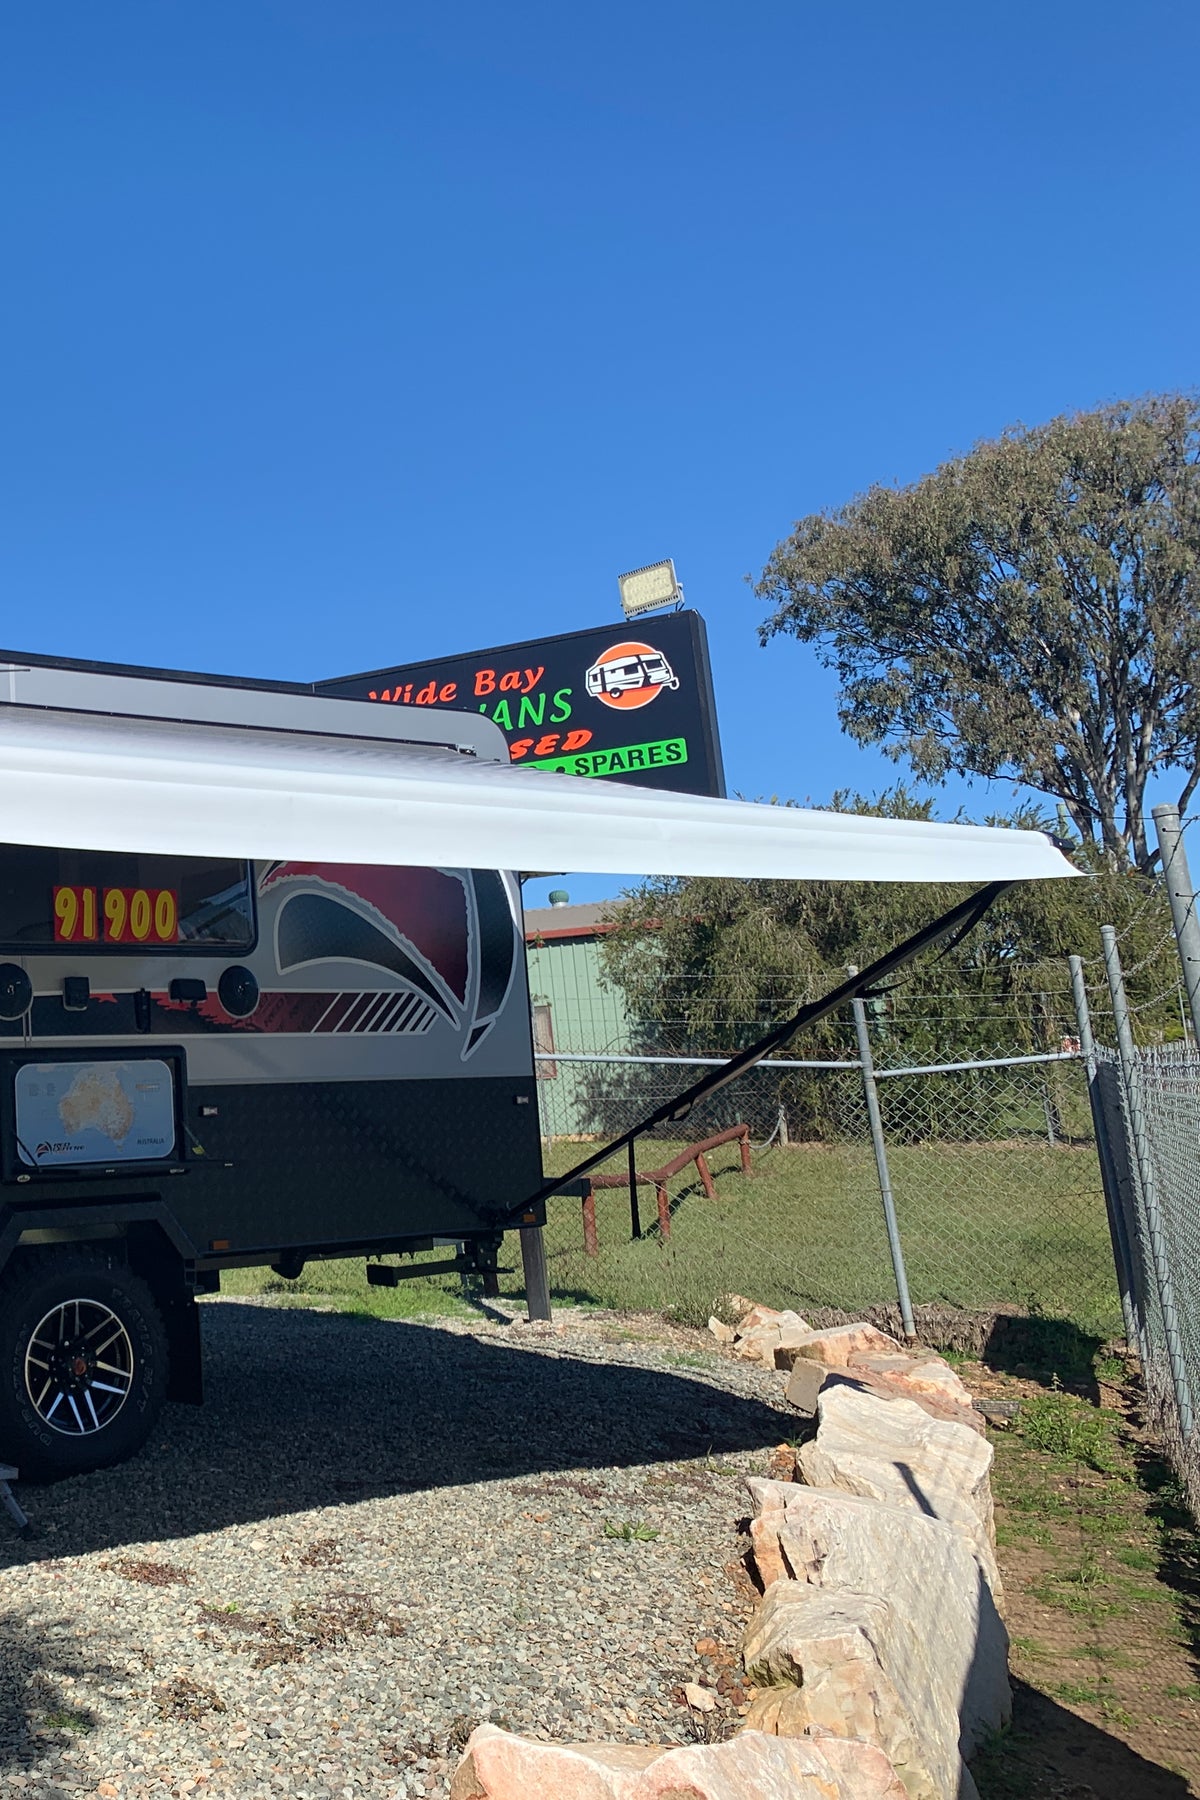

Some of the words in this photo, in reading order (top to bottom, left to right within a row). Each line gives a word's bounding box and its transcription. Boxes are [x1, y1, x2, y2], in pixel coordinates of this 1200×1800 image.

[474, 666, 545, 697] Bay
[479, 688, 574, 731] ANS
[509, 729, 593, 760] SED
[575, 742, 683, 776] SPARES
[137, 1137, 165, 1145] AUSTRALIA
